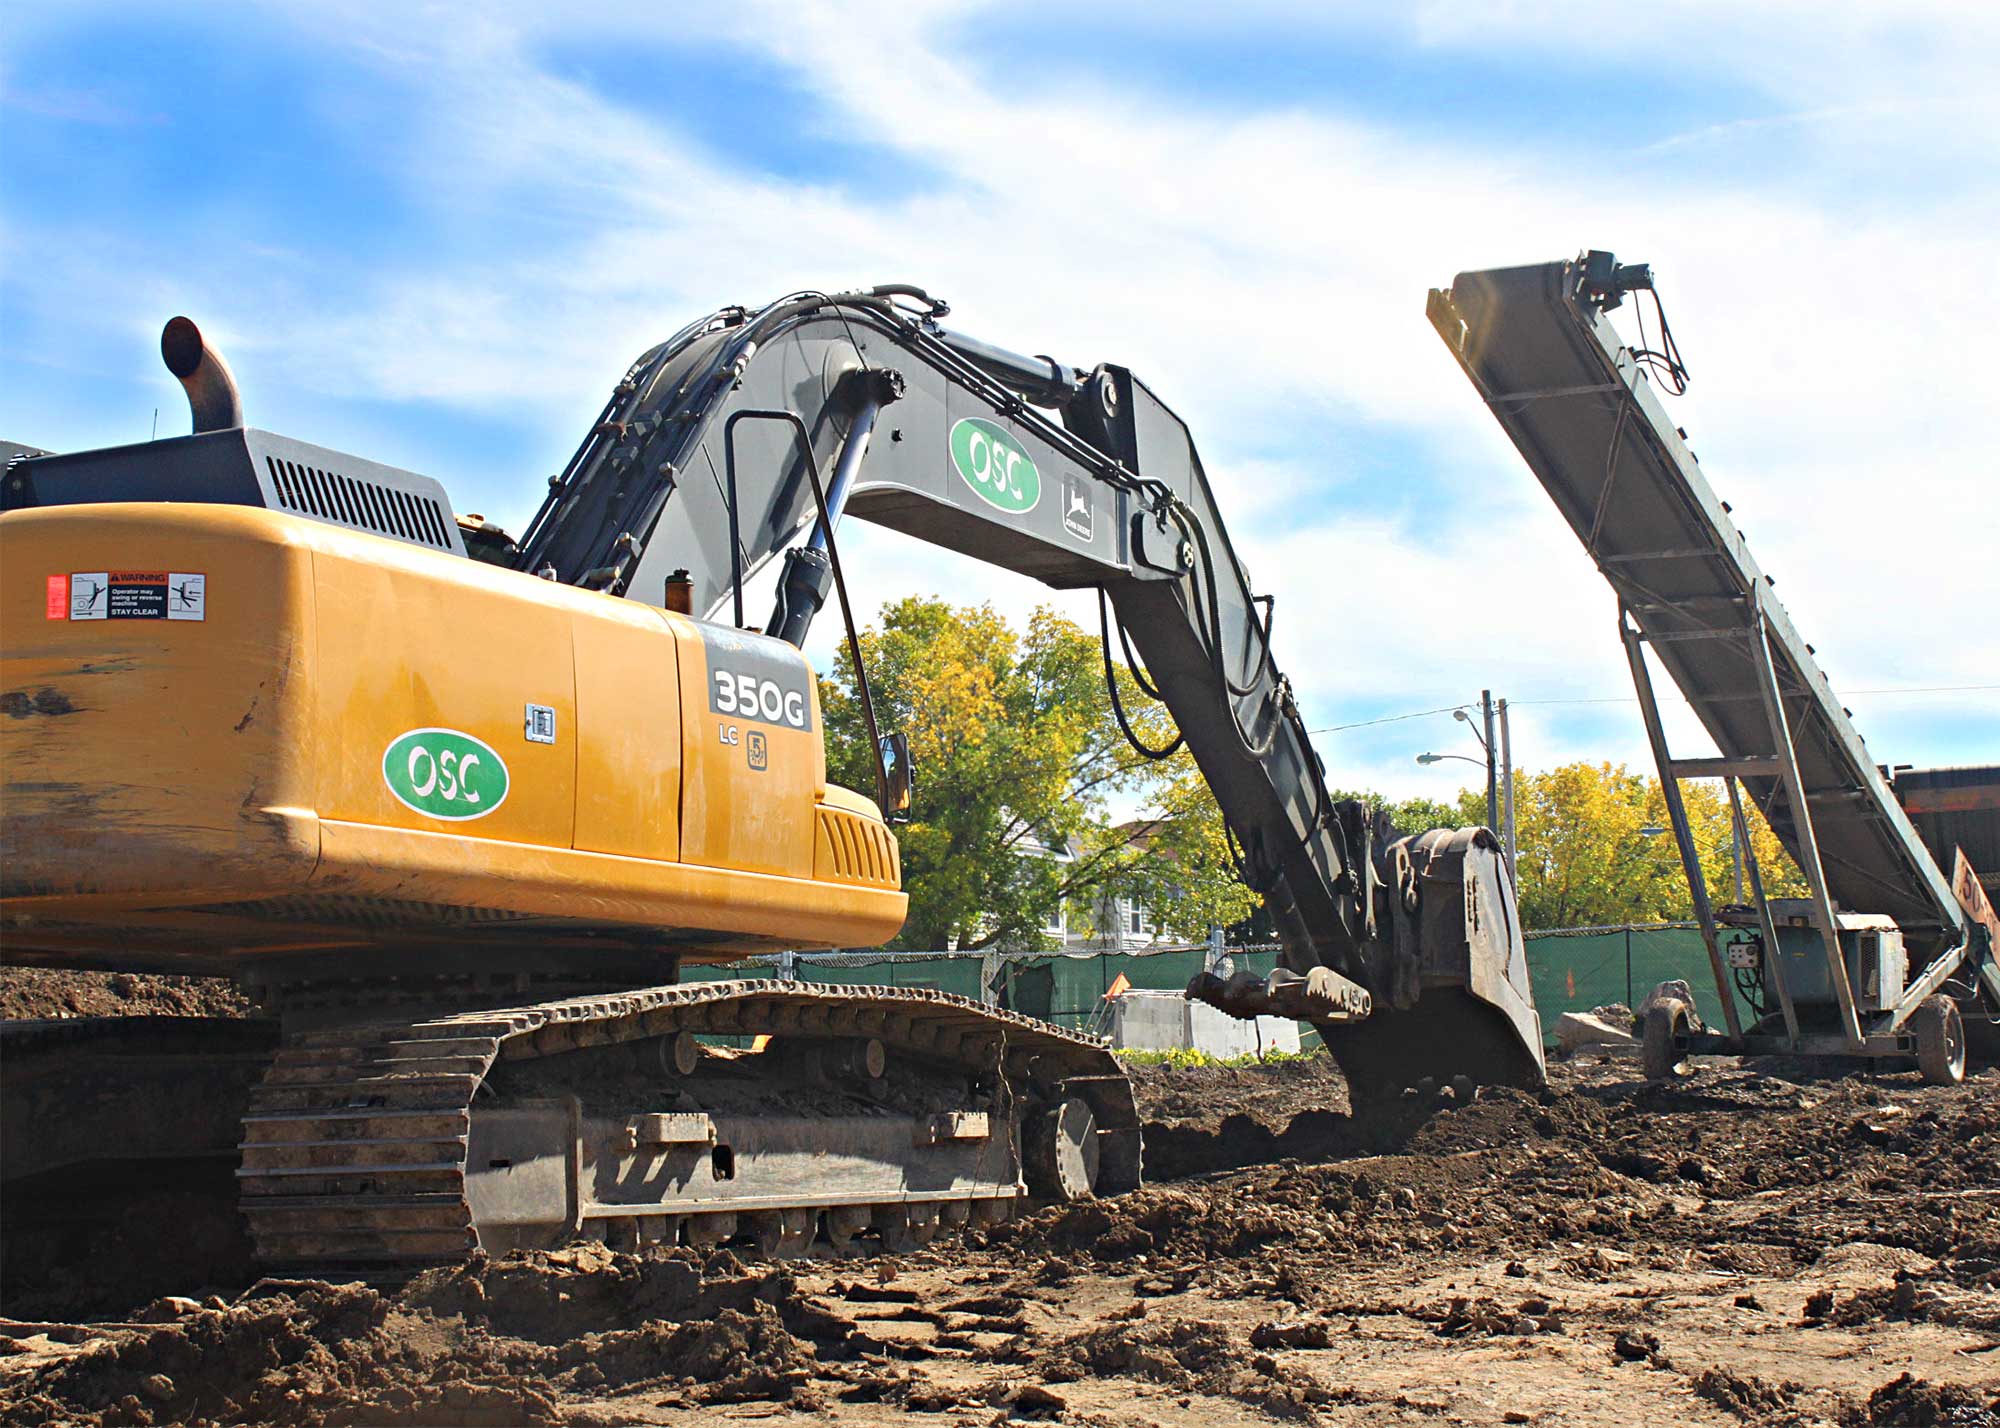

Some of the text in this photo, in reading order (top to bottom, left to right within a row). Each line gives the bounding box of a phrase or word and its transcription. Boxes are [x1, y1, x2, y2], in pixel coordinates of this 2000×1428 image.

[969, 432, 1024, 500] OSC
[120, 574, 165, 582] WARNING
[111, 588, 139, 596] Operator
[111, 608, 158, 616] STAY CLEAR
[715, 670, 804, 728] 350G
[719, 723, 738, 745] LC
[408, 745, 480, 803] OSC
